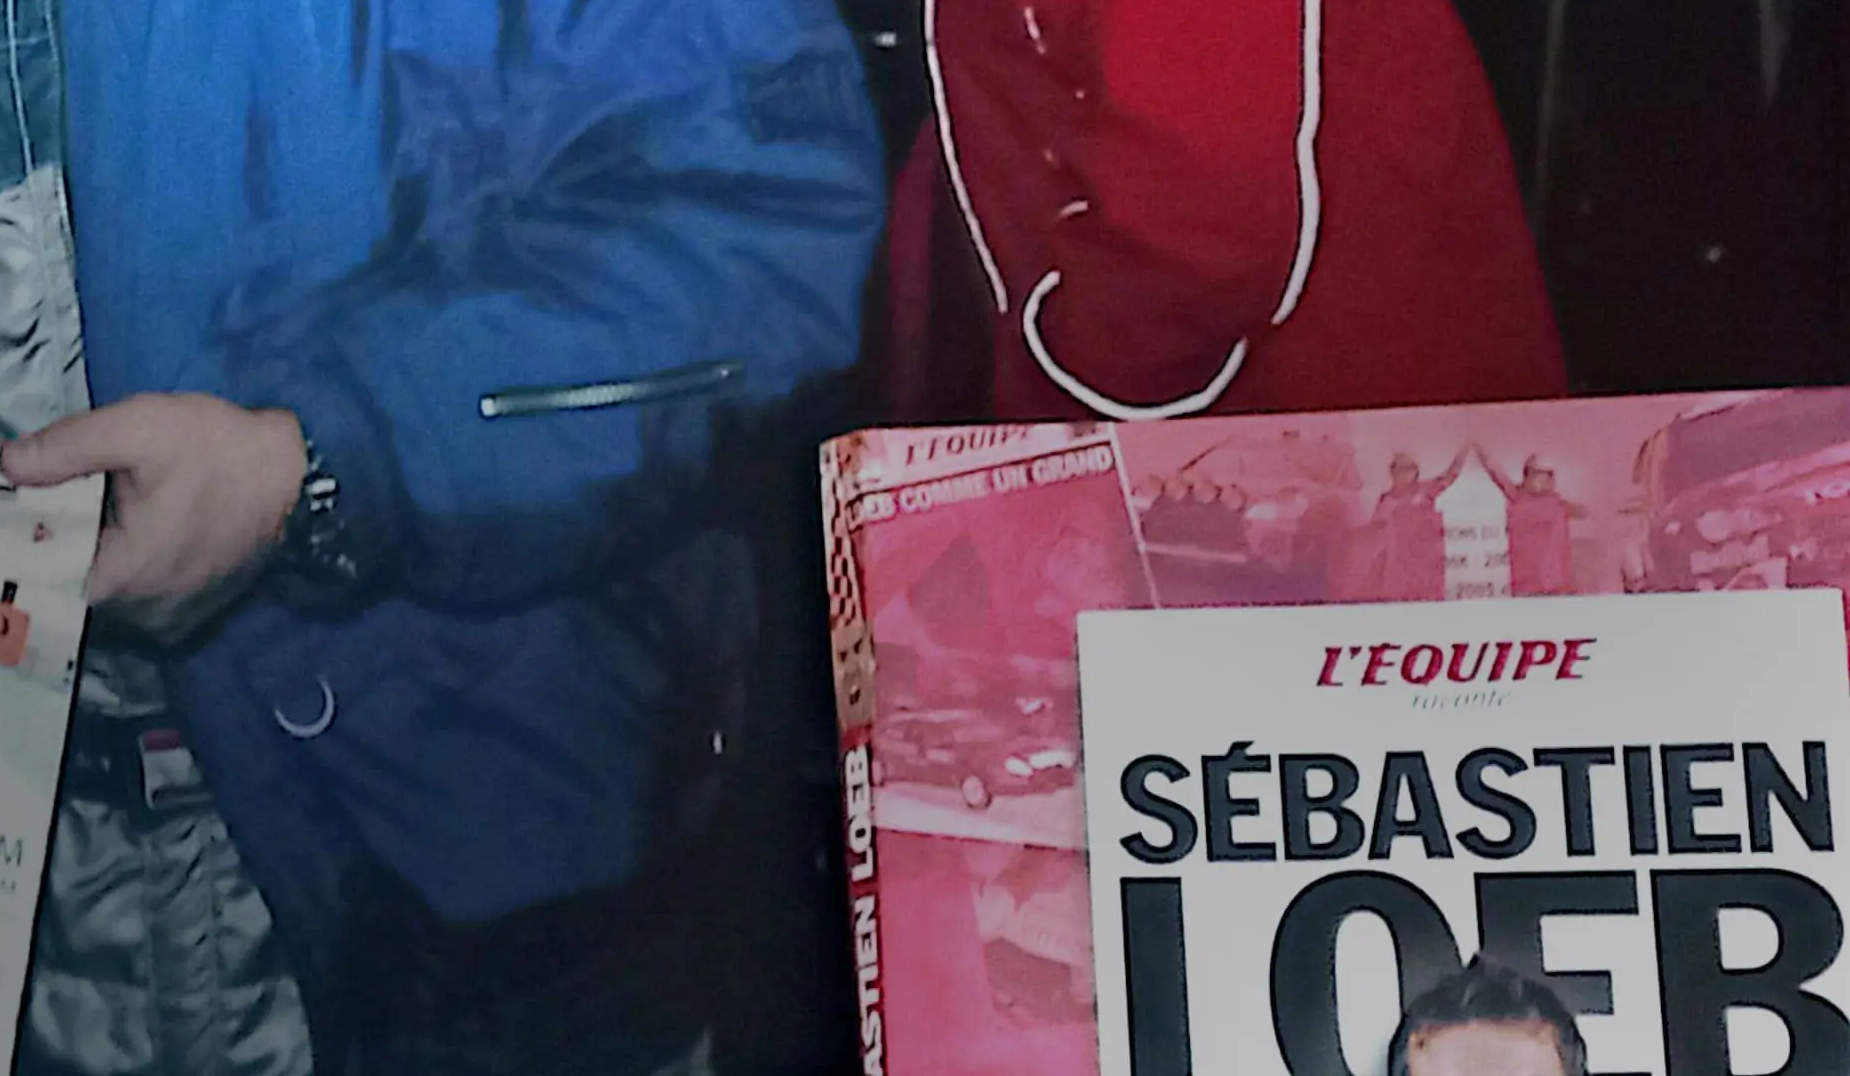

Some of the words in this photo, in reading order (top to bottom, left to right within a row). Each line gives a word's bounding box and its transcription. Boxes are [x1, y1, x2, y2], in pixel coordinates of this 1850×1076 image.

[993, 463, 1029, 495] UN
[1031, 445, 1114, 484] GRAND
[845, 744, 874, 882] LOEB
[1119, 741, 1834, 865] SÉBASTIEN
